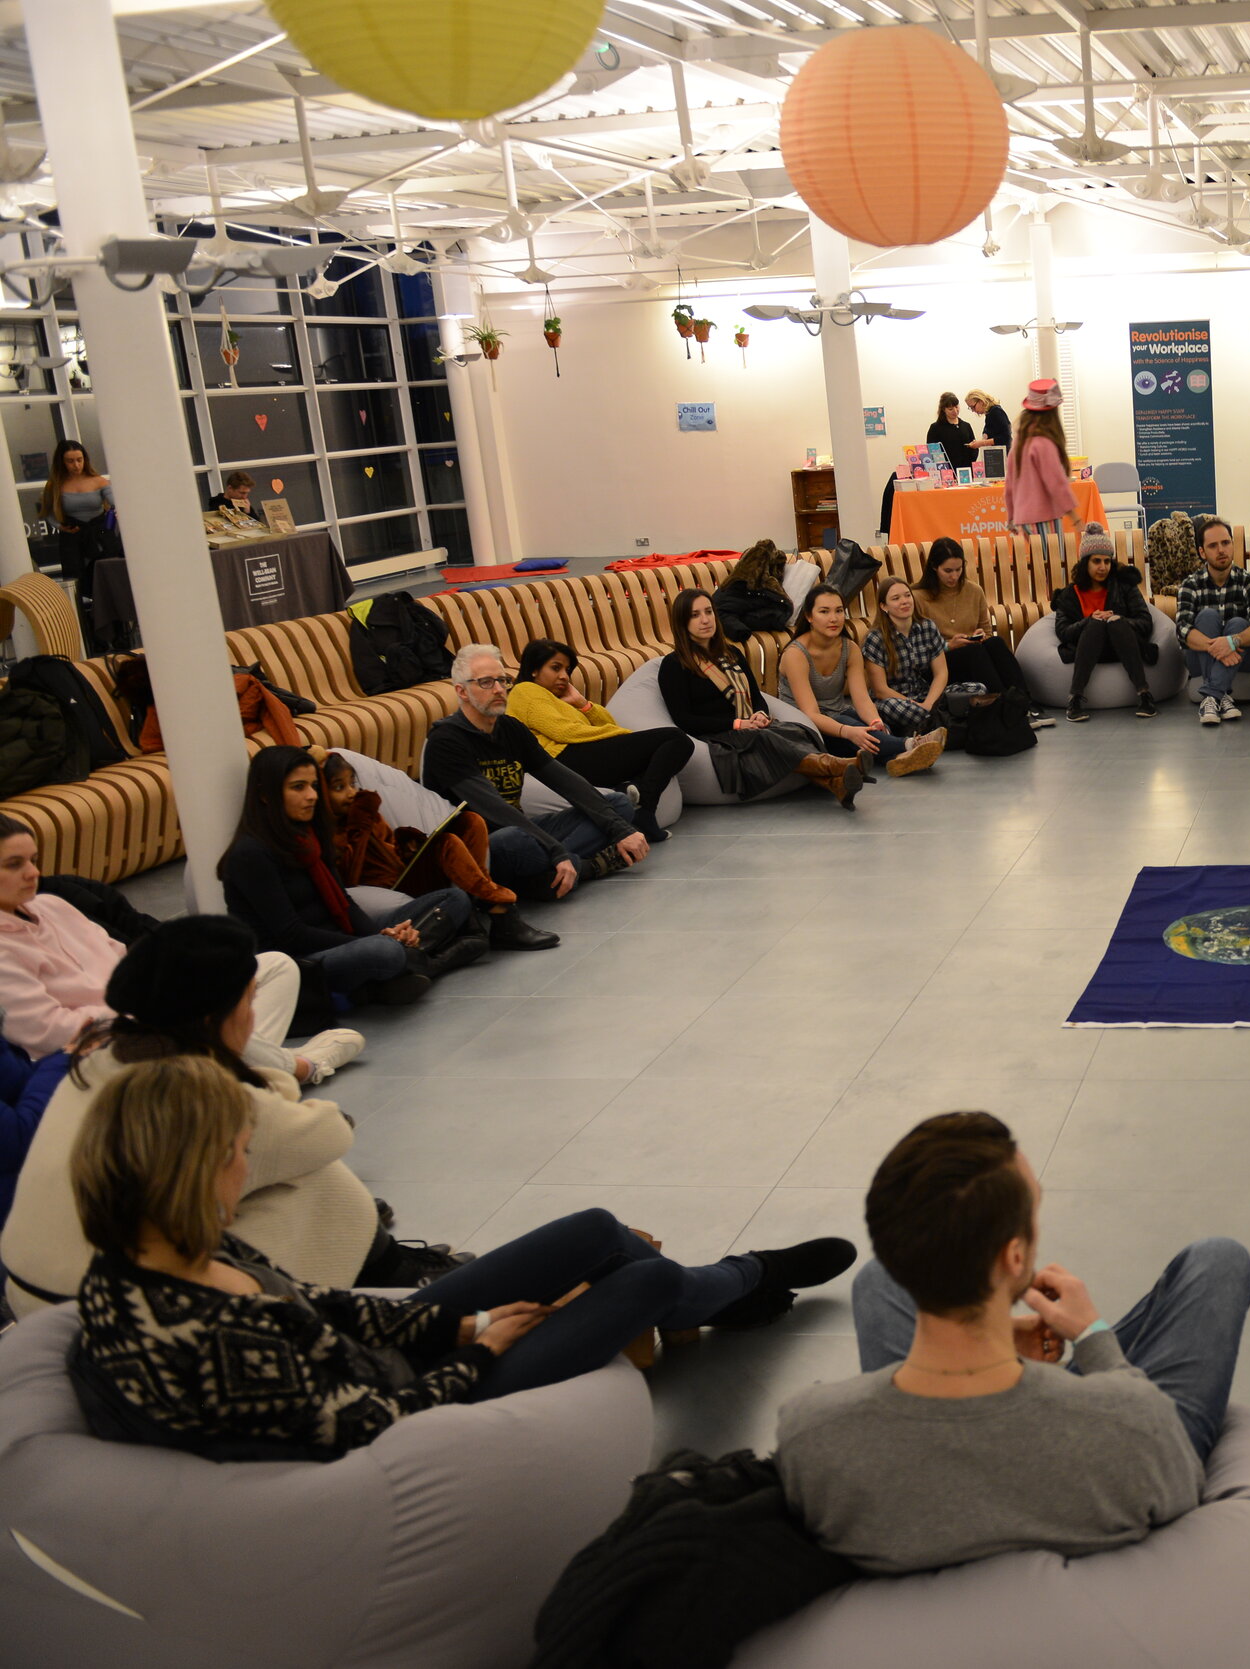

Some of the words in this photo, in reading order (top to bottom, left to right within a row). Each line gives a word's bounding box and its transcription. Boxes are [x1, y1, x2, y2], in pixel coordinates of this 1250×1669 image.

[1131, 329, 1208, 342] Revolutionise
[1132, 344, 1147, 352] your
[1149, 342, 1208, 356] Workplace
